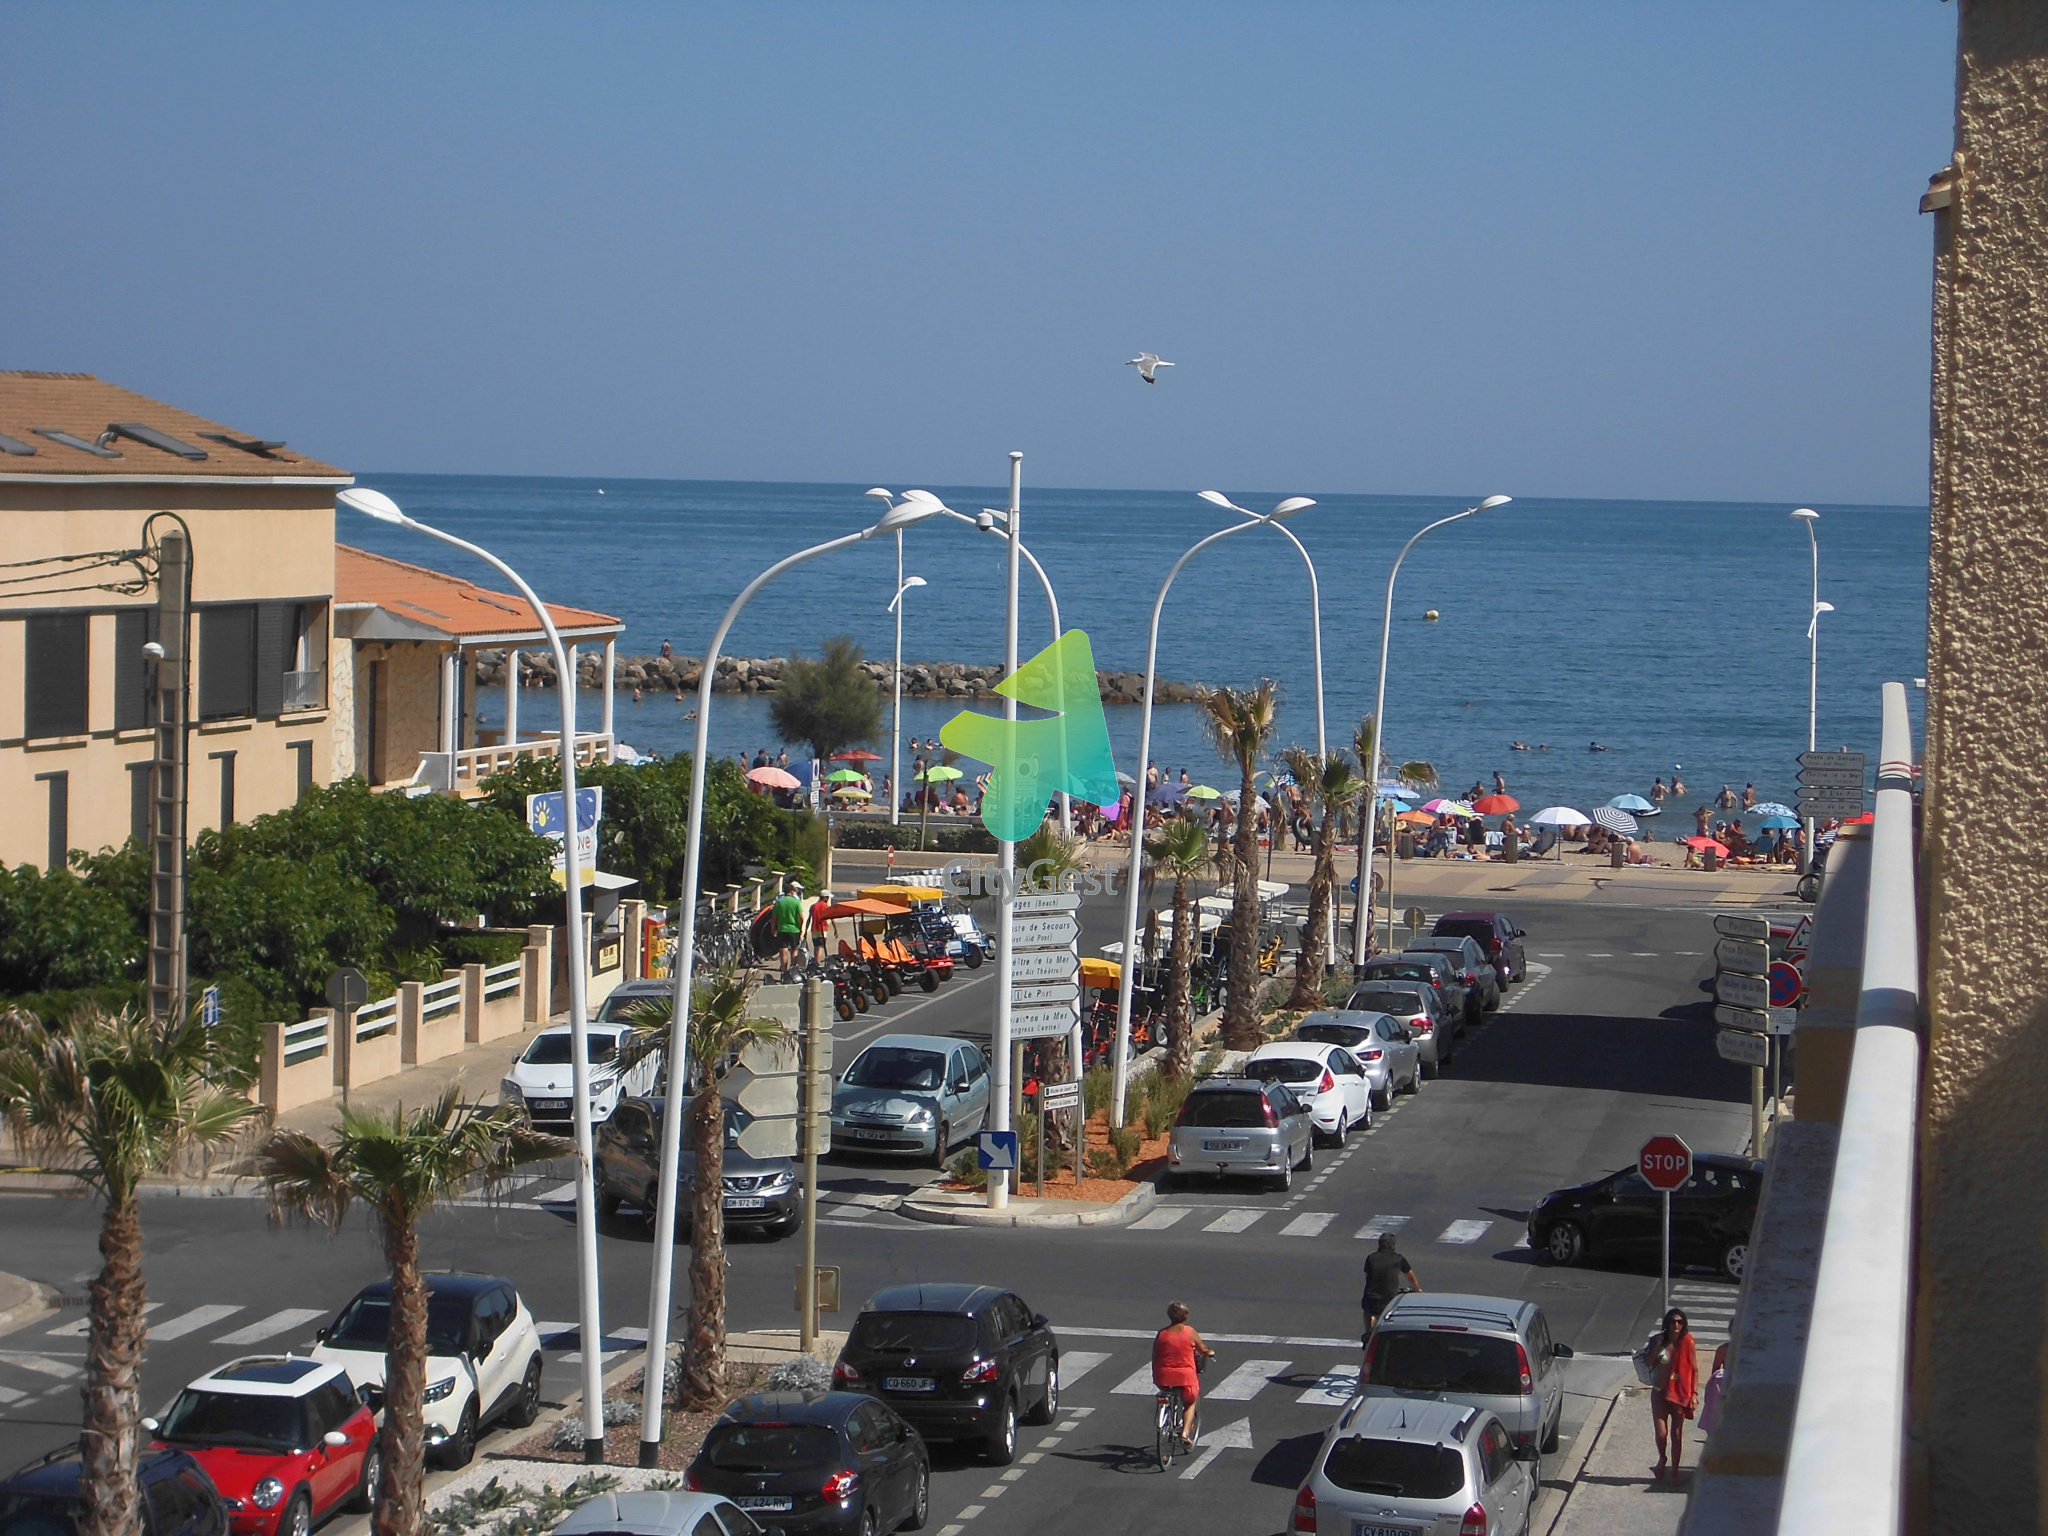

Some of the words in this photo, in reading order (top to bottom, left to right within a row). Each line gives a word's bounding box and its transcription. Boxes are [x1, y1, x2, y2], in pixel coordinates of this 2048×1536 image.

[1013, 901, 1031, 910] ages
[1029, 923, 1038, 931] de
[1042, 922, 1070, 931] Secours
[1046, 956, 1053, 964] la
[1056, 955, 1070, 964] Mer
[1024, 990, 1032, 999] Le
[1036, 989, 1052, 998] Port
[1043, 1013, 1050, 1021] la
[1053, 1011, 1068, 1020] Mer
[1644, 1154, 1686, 1170] STOP
